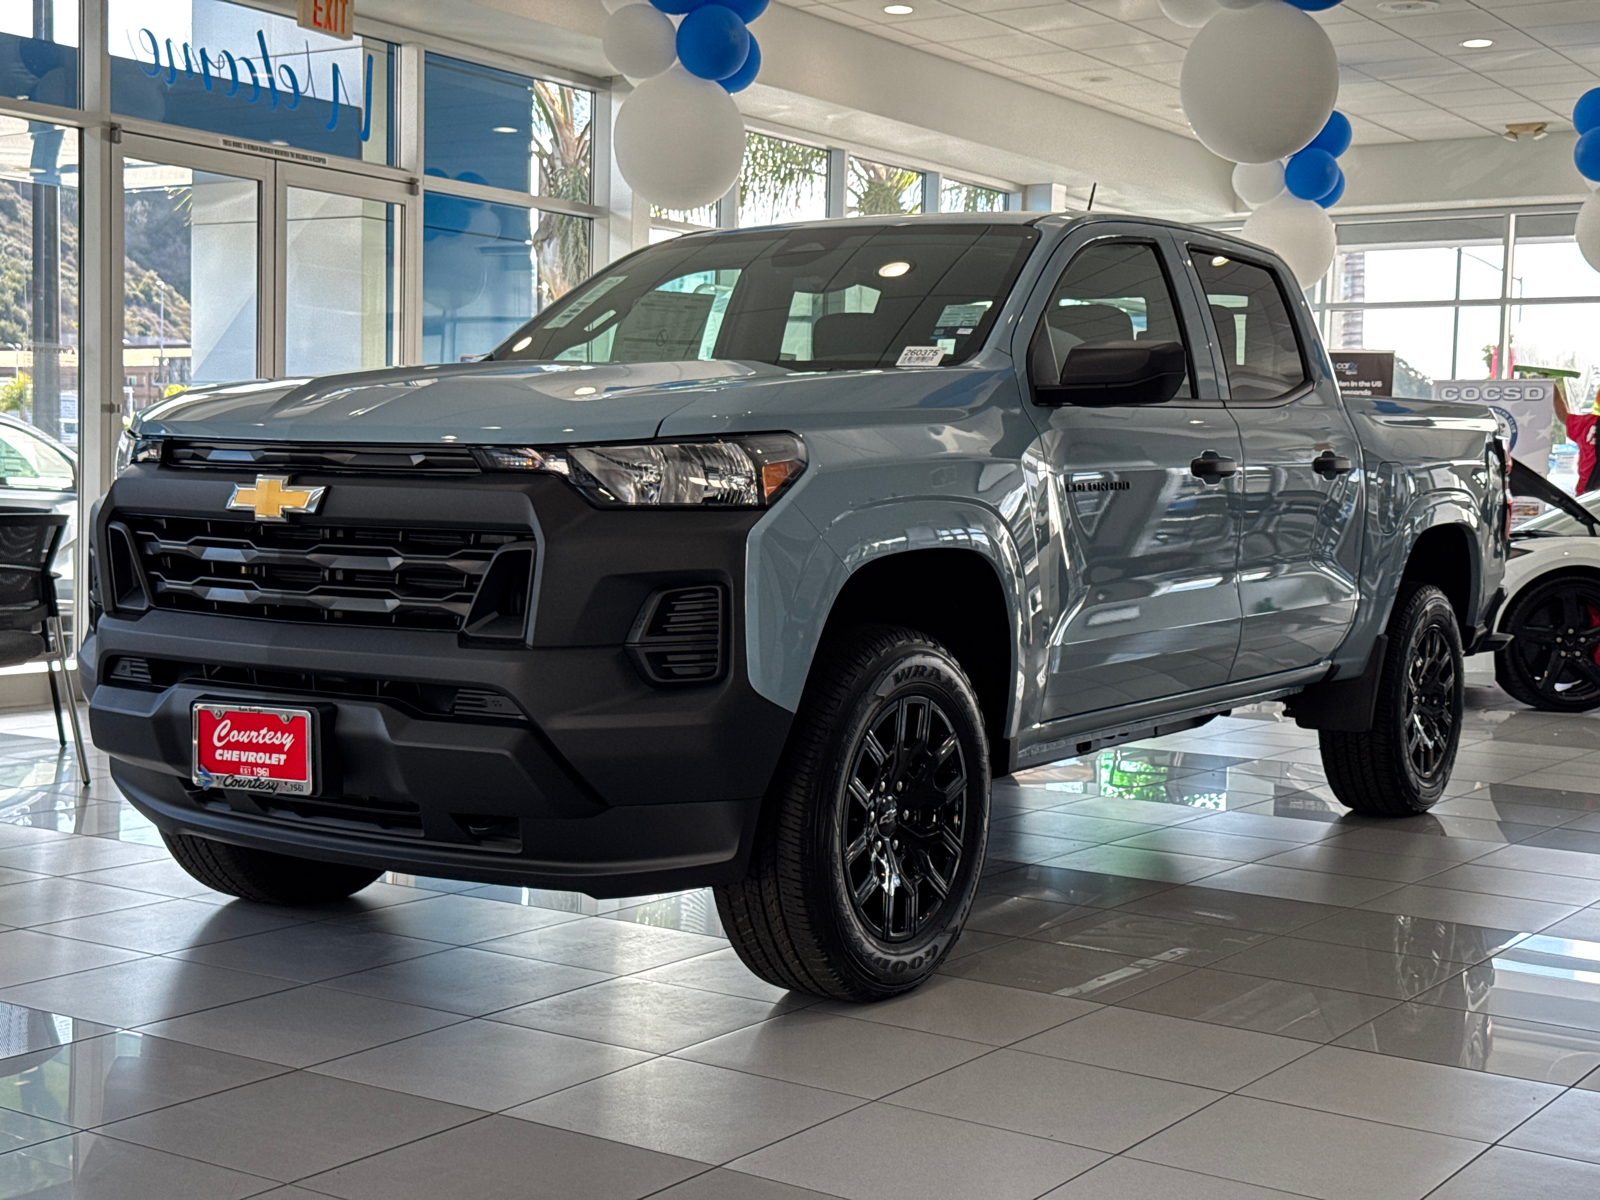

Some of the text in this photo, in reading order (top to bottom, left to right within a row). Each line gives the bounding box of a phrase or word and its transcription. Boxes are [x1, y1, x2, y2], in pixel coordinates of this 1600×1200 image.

[312, 0, 348, 35] EXIT
[904, 349, 940, 357] 260375
[1371, 380, 1383, 388] US
[1440, 386, 1546, 401] COCSD
[213, 719, 295, 752] Courtesy
[215, 749, 287, 766] CHEVROLET
[240, 766, 270, 777] EST 1961
[222, 774, 280, 794] Courtesy
